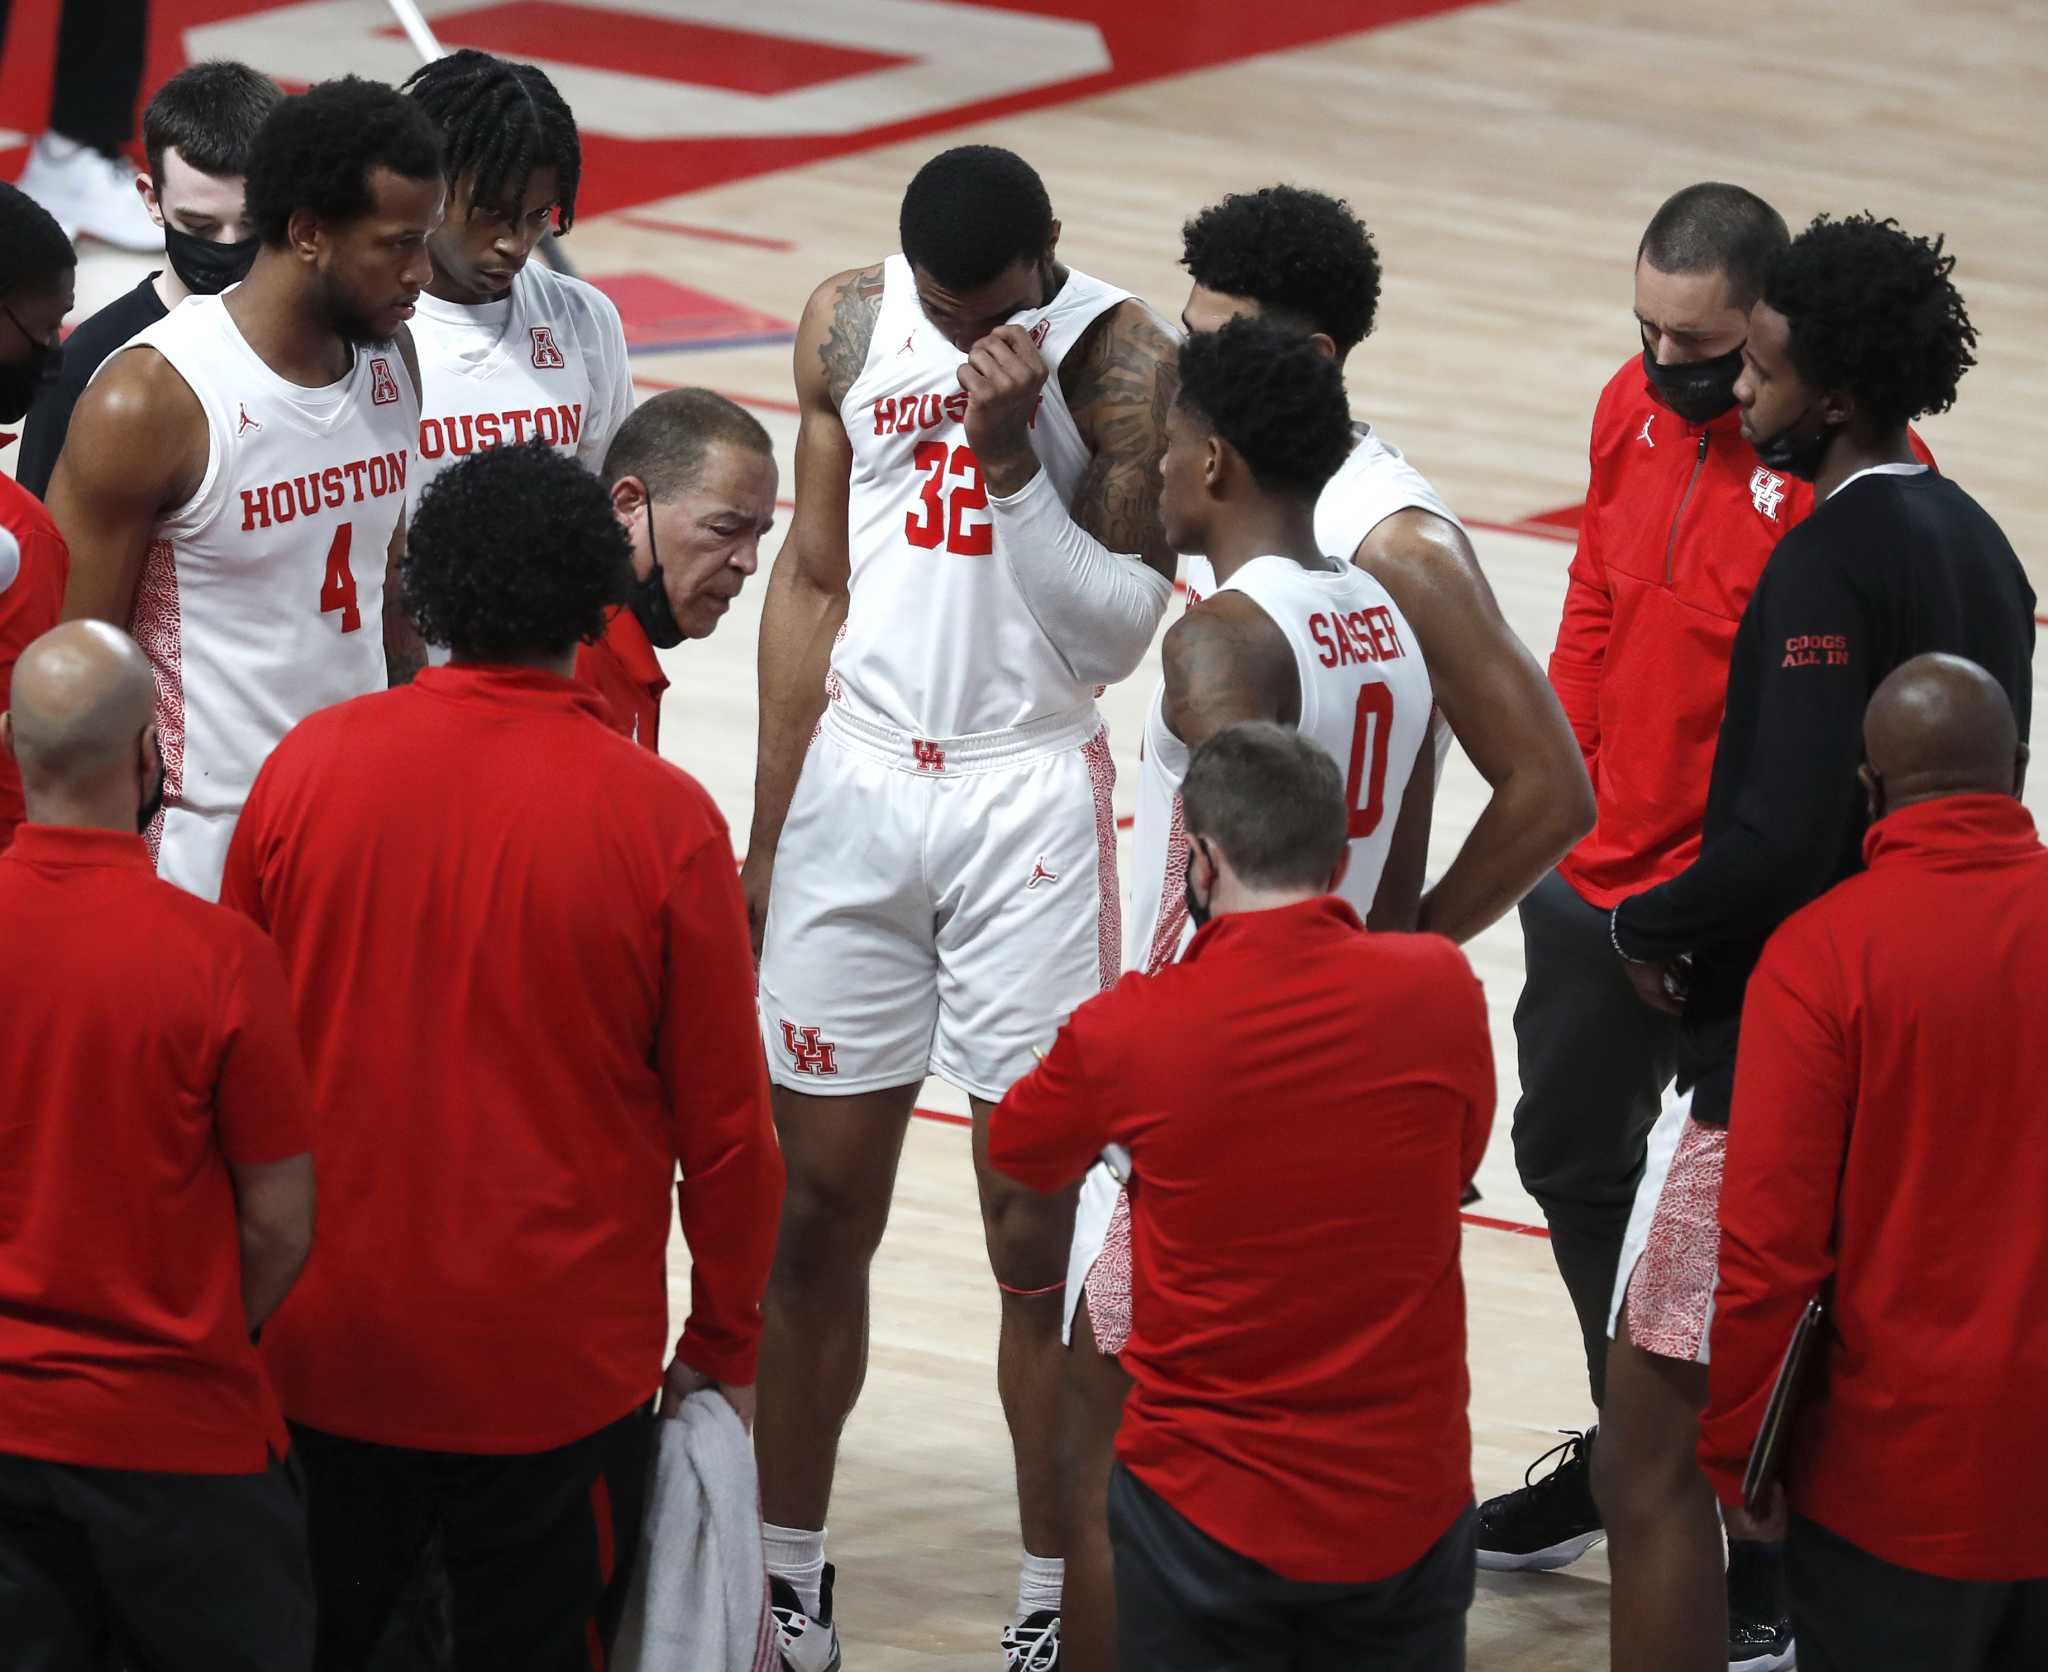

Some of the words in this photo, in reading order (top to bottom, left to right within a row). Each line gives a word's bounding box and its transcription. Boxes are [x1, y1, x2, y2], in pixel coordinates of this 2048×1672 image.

[415, 403, 582, 460] OUSTON
[873, 392, 1044, 436] HOUS
[239, 449, 408, 532] HOUSTON
[904, 440, 993, 556] 32
[1749, 466, 1785, 523] UH
[319, 521, 362, 634] 4
[1308, 605, 1406, 669] SASSER
[1781, 651, 1823, 668] ALL
[1826, 650, 1849, 665] IN
[1785, 635, 1848, 652] COOGS
[1345, 681, 1394, 839] 0
[779, 1018, 838, 1075] UH
